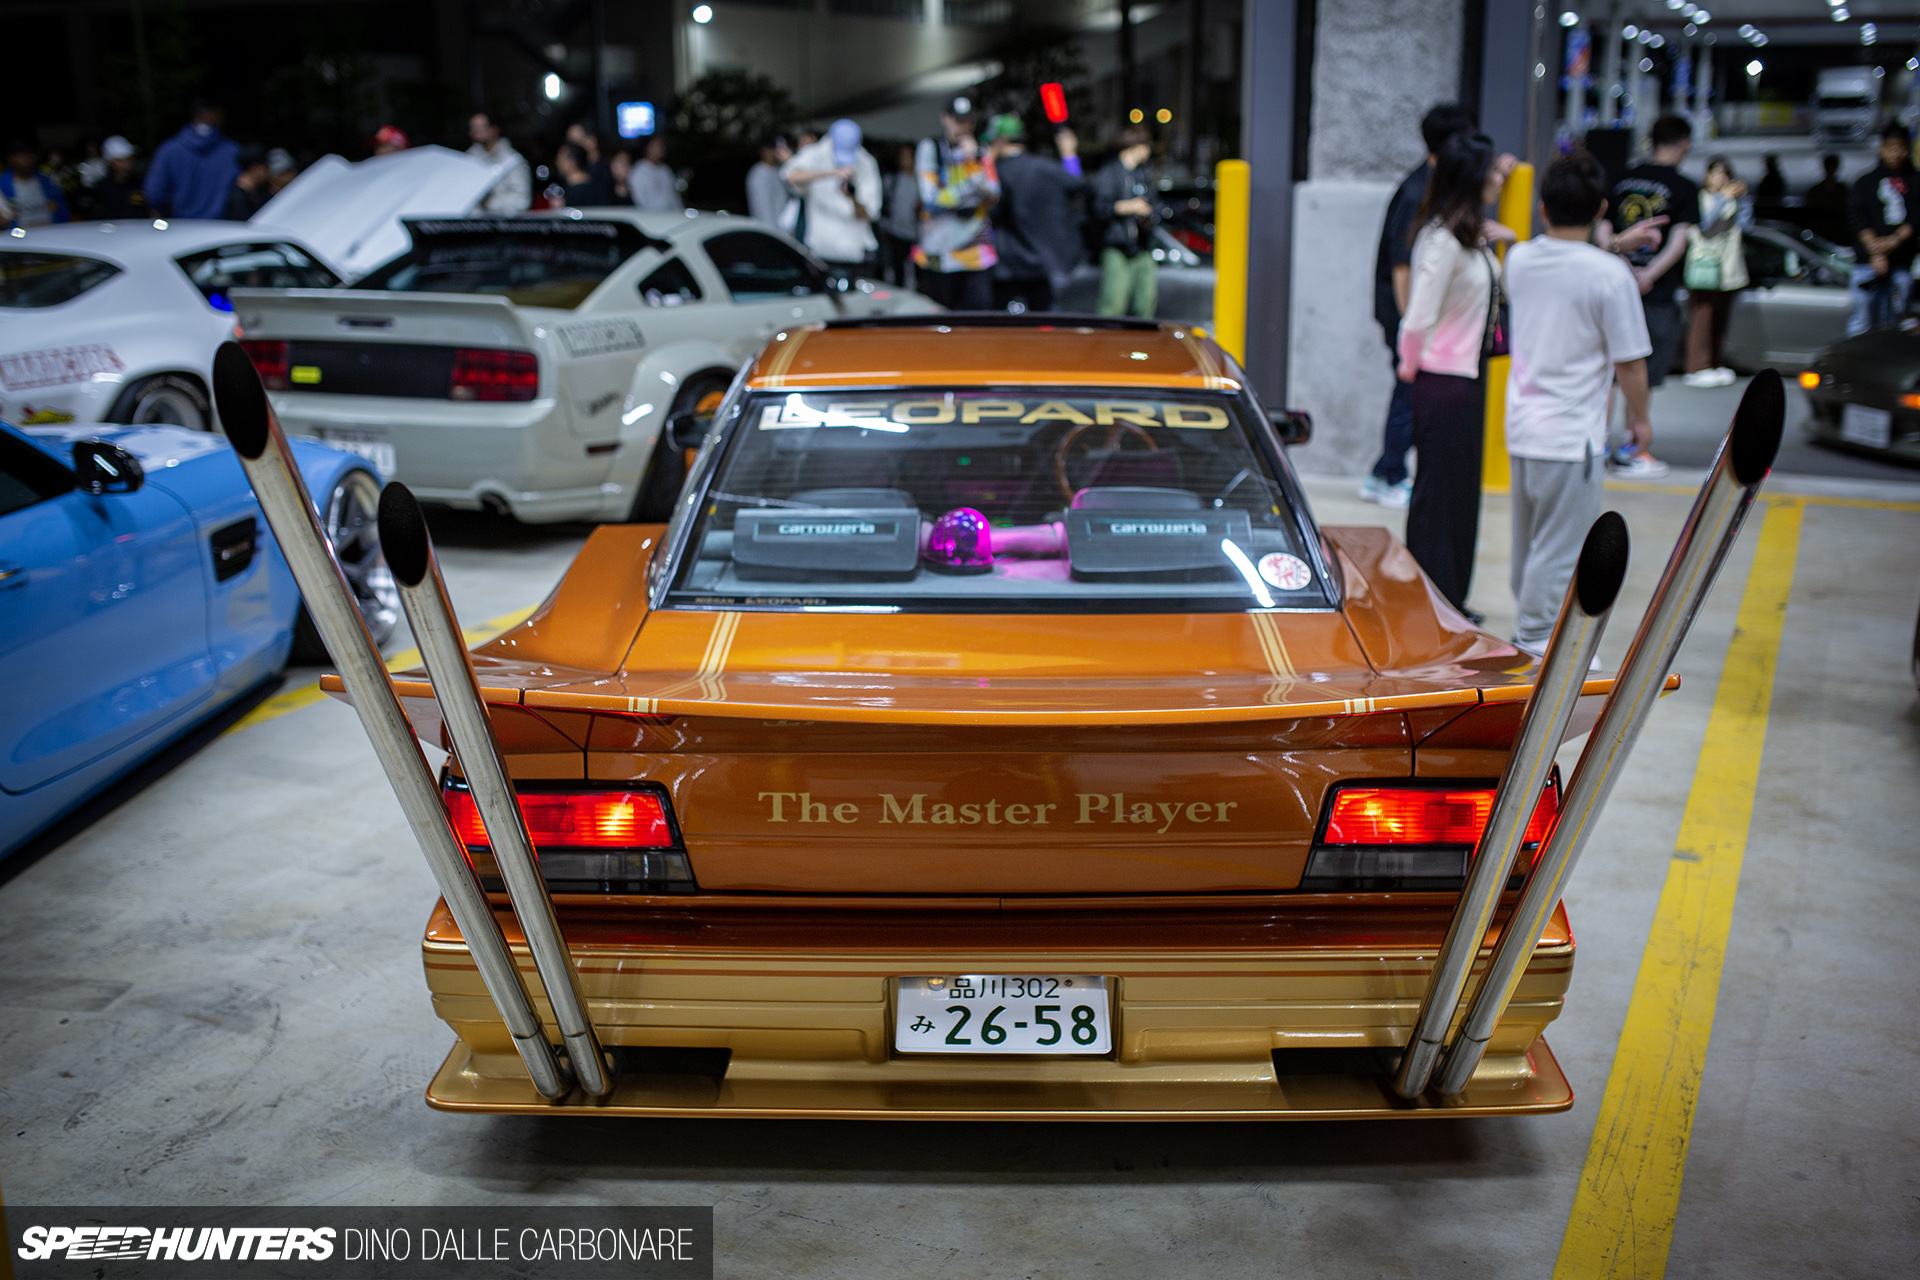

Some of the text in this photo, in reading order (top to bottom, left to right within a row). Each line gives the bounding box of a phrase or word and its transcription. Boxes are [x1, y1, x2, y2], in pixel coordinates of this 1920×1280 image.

[757, 402, 1231, 431] LEOPARD
[758, 792, 1238, 834] The Master Player
[910, 1004, 1098, 1045] み 26-58
